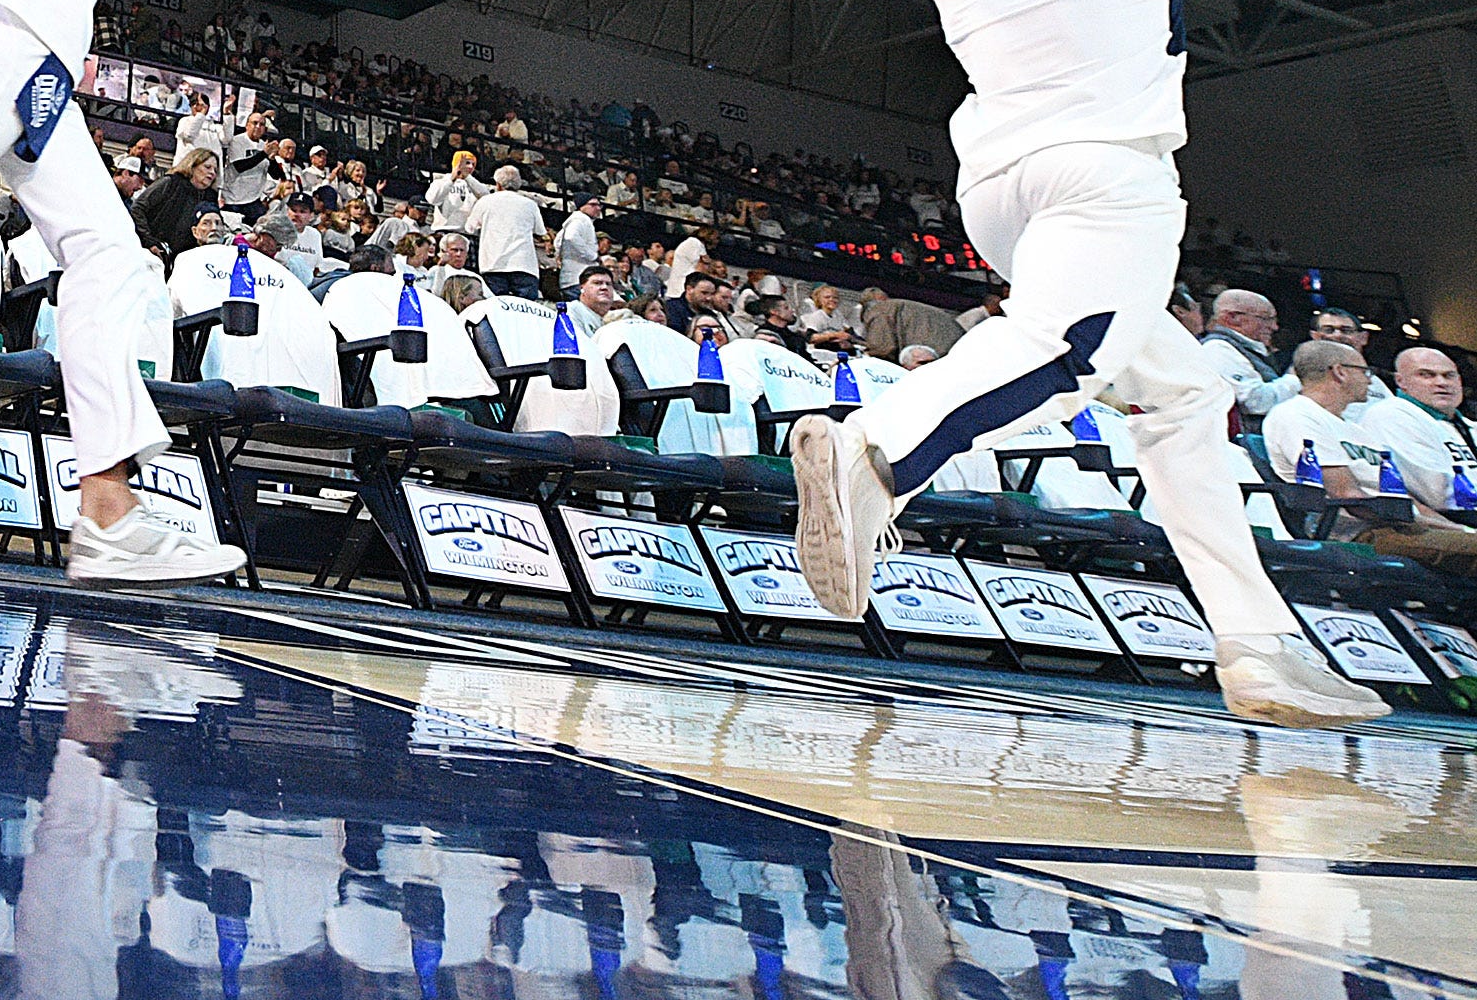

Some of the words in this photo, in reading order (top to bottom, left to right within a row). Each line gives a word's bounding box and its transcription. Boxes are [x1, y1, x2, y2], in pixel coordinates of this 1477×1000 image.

[465, 42, 492, 61] 219
[721, 103, 747, 120] 220
[419, 503, 550, 555] CAPITAL
[444, 550, 549, 577] WILMINGTON
[579, 527, 703, 576] CAPITAL
[716, 541, 802, 576] CAPIT
[605, 573, 705, 598] WILMINGTON
[986, 576, 1093, 621] CAPITAL
[1103, 590, 1204, 631] CAPITAL
